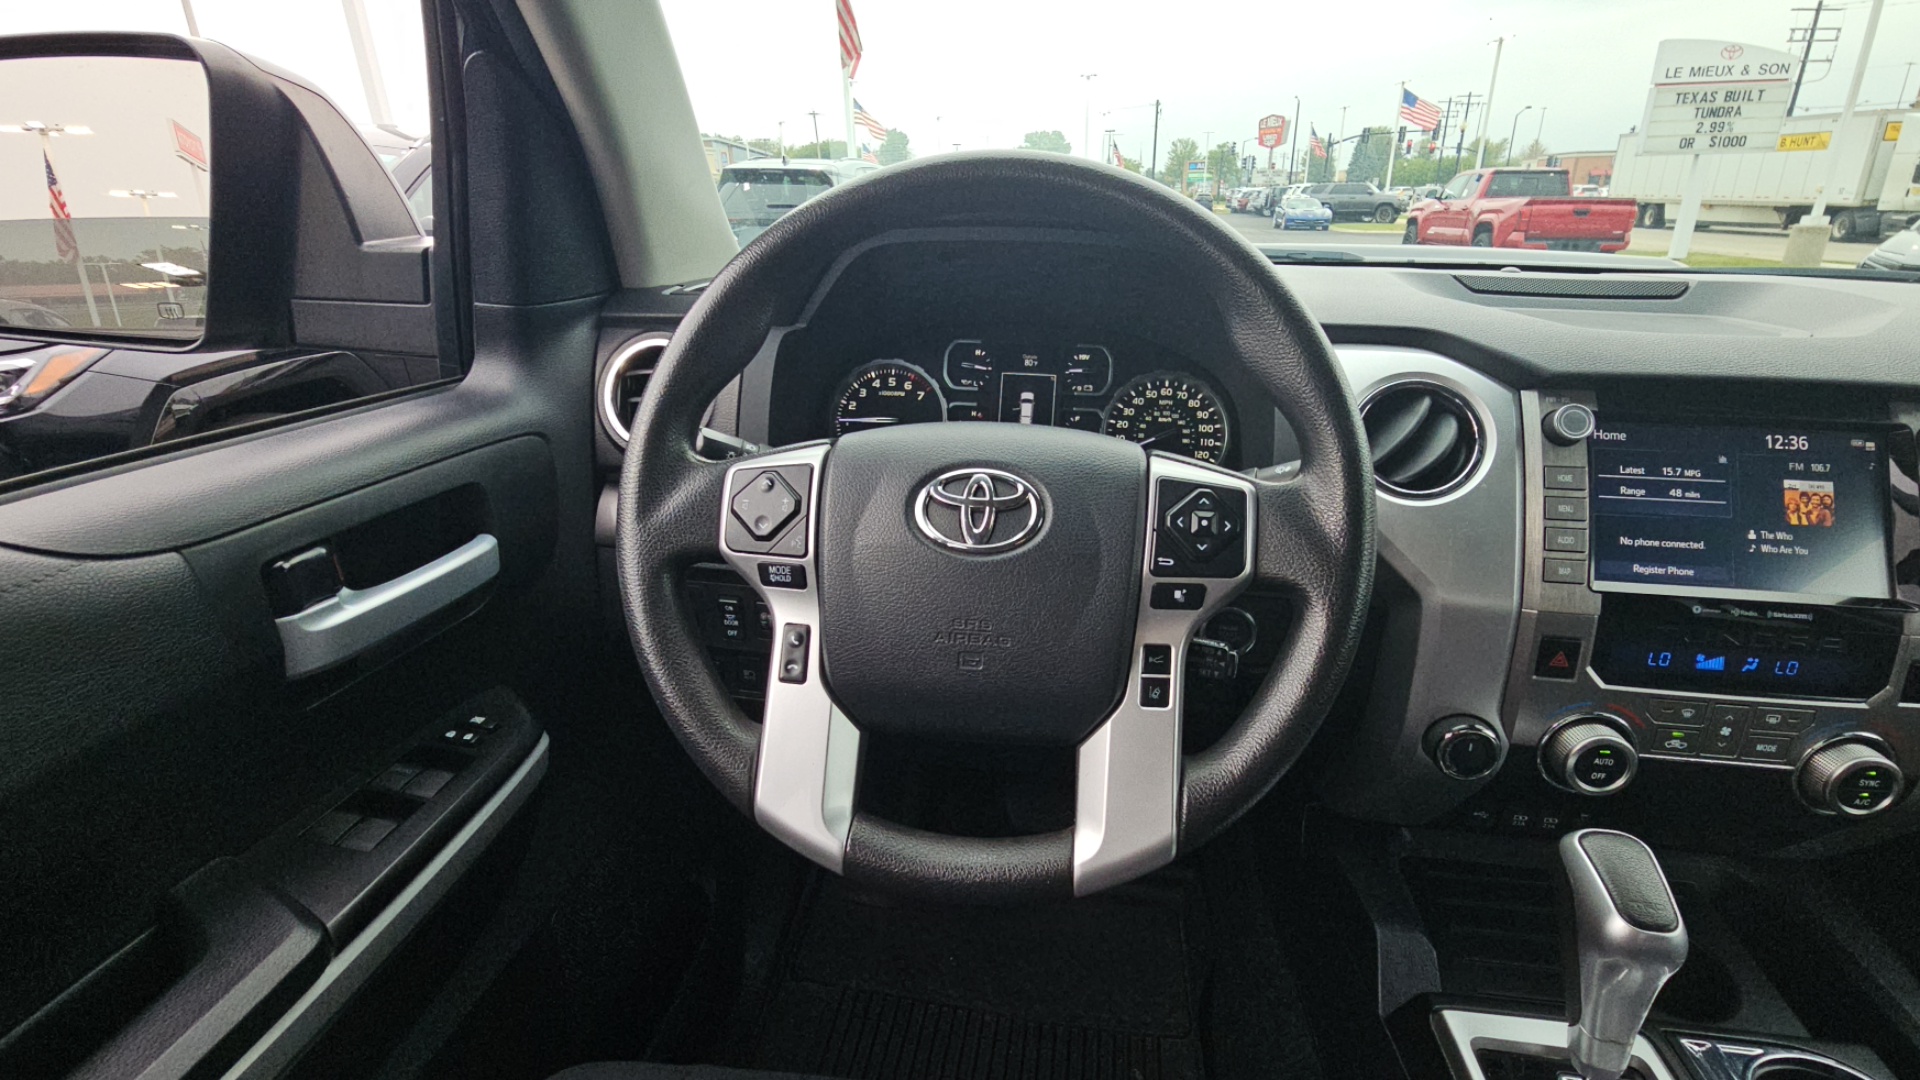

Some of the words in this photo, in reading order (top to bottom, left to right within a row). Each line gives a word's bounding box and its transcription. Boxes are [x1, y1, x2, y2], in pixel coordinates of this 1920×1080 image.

[1665, 66, 1683, 79] LE
[1740, 64, 1750, 76] &
[1758, 62, 1791, 76] SON
[1676, 91, 1718, 105] TEXAS
[1724, 89, 1766, 103] BUILT
[1694, 105, 1742, 119] TUNDRA
[1696, 121, 1734, 134] 2.99%
[1679, 138, 1695, 149] OR
[1789, 136, 1816, 147] HUNT
[872, 379, 880, 388] 4
[888, 377, 896, 387] 5
[904, 381, 912, 390] 6
[859, 388, 867, 397] 3
[917, 391, 925, 400] 7
[1160, 388, 1173, 396] 60
[848, 401, 857, 410] 2
[1188, 400, 1200, 408] 80
[1196, 411, 1209, 419] 90
[1198, 424, 1214, 432] 100
[1594, 429, 1627, 441] Home
[1200, 438, 1214, 446] 110
[1765, 435, 1809, 450] 12:36
[1194, 451, 1209, 459] 120
[1620, 465, 1645, 474] Latest
[1662, 467, 1682, 476] 15.7
[1789, 462, 1804, 471] FM
[1810, 463, 1831, 472] 106.7
[1620, 486, 1646, 496] Range
[1669, 489, 1682, 497] 48
[1558, 505, 1573, 513] MENU
[1760, 530, 1775, 540] The
[1776, 532, 1793, 540] Who
[1557, 536, 1574, 544] AUDIO
[1620, 536, 1633, 546] No
[1635, 538, 1660, 547] phone
[1761, 544, 1778, 553] Who
[1779, 545, 1793, 554] Are
[1794, 546, 1808, 555] You
[768, 566, 791, 575] MODE
[1633, 564, 1666, 576] Register
[1667, 565, 1694, 576] Phone
[1648, 652, 1671, 668] LO
[1775, 661, 1799, 676] LO
[1756, 744, 1778, 752] MODE
[1593, 758, 1614, 766] AUTO
[1591, 772, 1606, 780] OFF
[1859, 779, 1881, 788] SYNC
